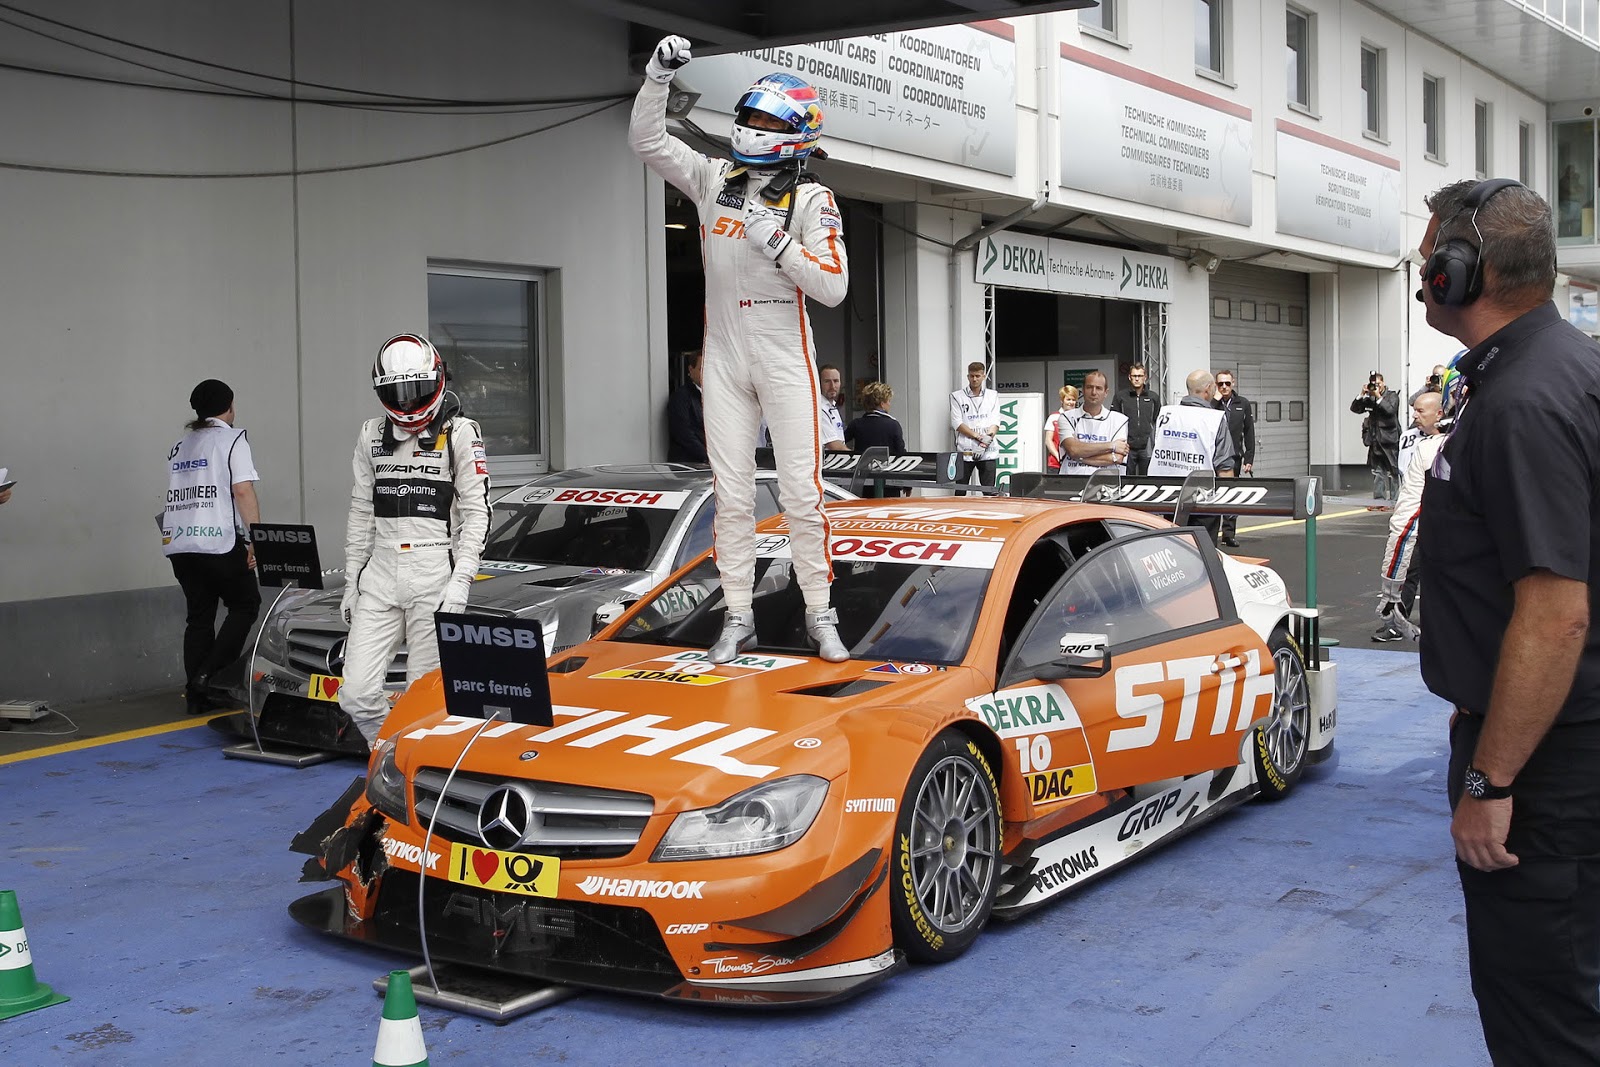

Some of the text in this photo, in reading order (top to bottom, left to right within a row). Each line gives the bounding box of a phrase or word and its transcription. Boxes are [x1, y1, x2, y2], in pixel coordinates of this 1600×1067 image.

[847, 43, 877, 65] CARS
[899, 33, 981, 72] KOORDINATOREN
[797, 55, 892, 95] D'ORGANISATION
[888, 55, 964, 90] COORDINATORS
[902, 85, 986, 120] COORDONATEURS
[1124, 105, 1207, 141] TECHNISCHE KOMMISSARE
[1121, 125, 1210, 161] TECHNICAL COMMISSIONERS
[1121, 146, 1210, 179] COMMISSAIRES TECHNIQUES
[1320, 163, 1347, 180] TECHNISCHE
[1003, 244, 1169, 290] DEKRA Technische Abnahme DEKRA
[393, 372, 429, 382] AMG
[995, 400, 1018, 488] DEKRA
[1163, 430, 1198, 439] DMSB
[172, 459, 208, 471] DMSB
[1154, 449, 1205, 464] SCRUTINEER
[391, 465, 441, 475] AMG
[166, 485, 217, 502] CRUTINEER
[553, 489, 664, 505] BOSCH
[186, 526, 223, 537] DEKRA
[254, 529, 312, 544] DMSB
[831, 538, 963, 562] OSCH
[1151, 548, 1177, 572] WIC
[263, 561, 310, 573] parc fermé
[1150, 569, 1186, 590] Wickens
[1244, 570, 1269, 589] GRIP
[439, 622, 537, 649] DMSB
[664, 661, 716, 674] 10
[676, 652, 776, 668] DRA
[624, 671, 699, 683] ADAC
[453, 678, 532, 698] parc fermé
[980, 692, 1065, 733] DEKRA
[1016, 734, 1052, 774] 10
[845, 798, 896, 813] SYNTIUM
[1117, 789, 1182, 842] GRIP
[1033, 845, 1099, 894] PETRONAS
[664, 923, 709, 935] GRIP
[701, 956, 754, 974] Thomas
